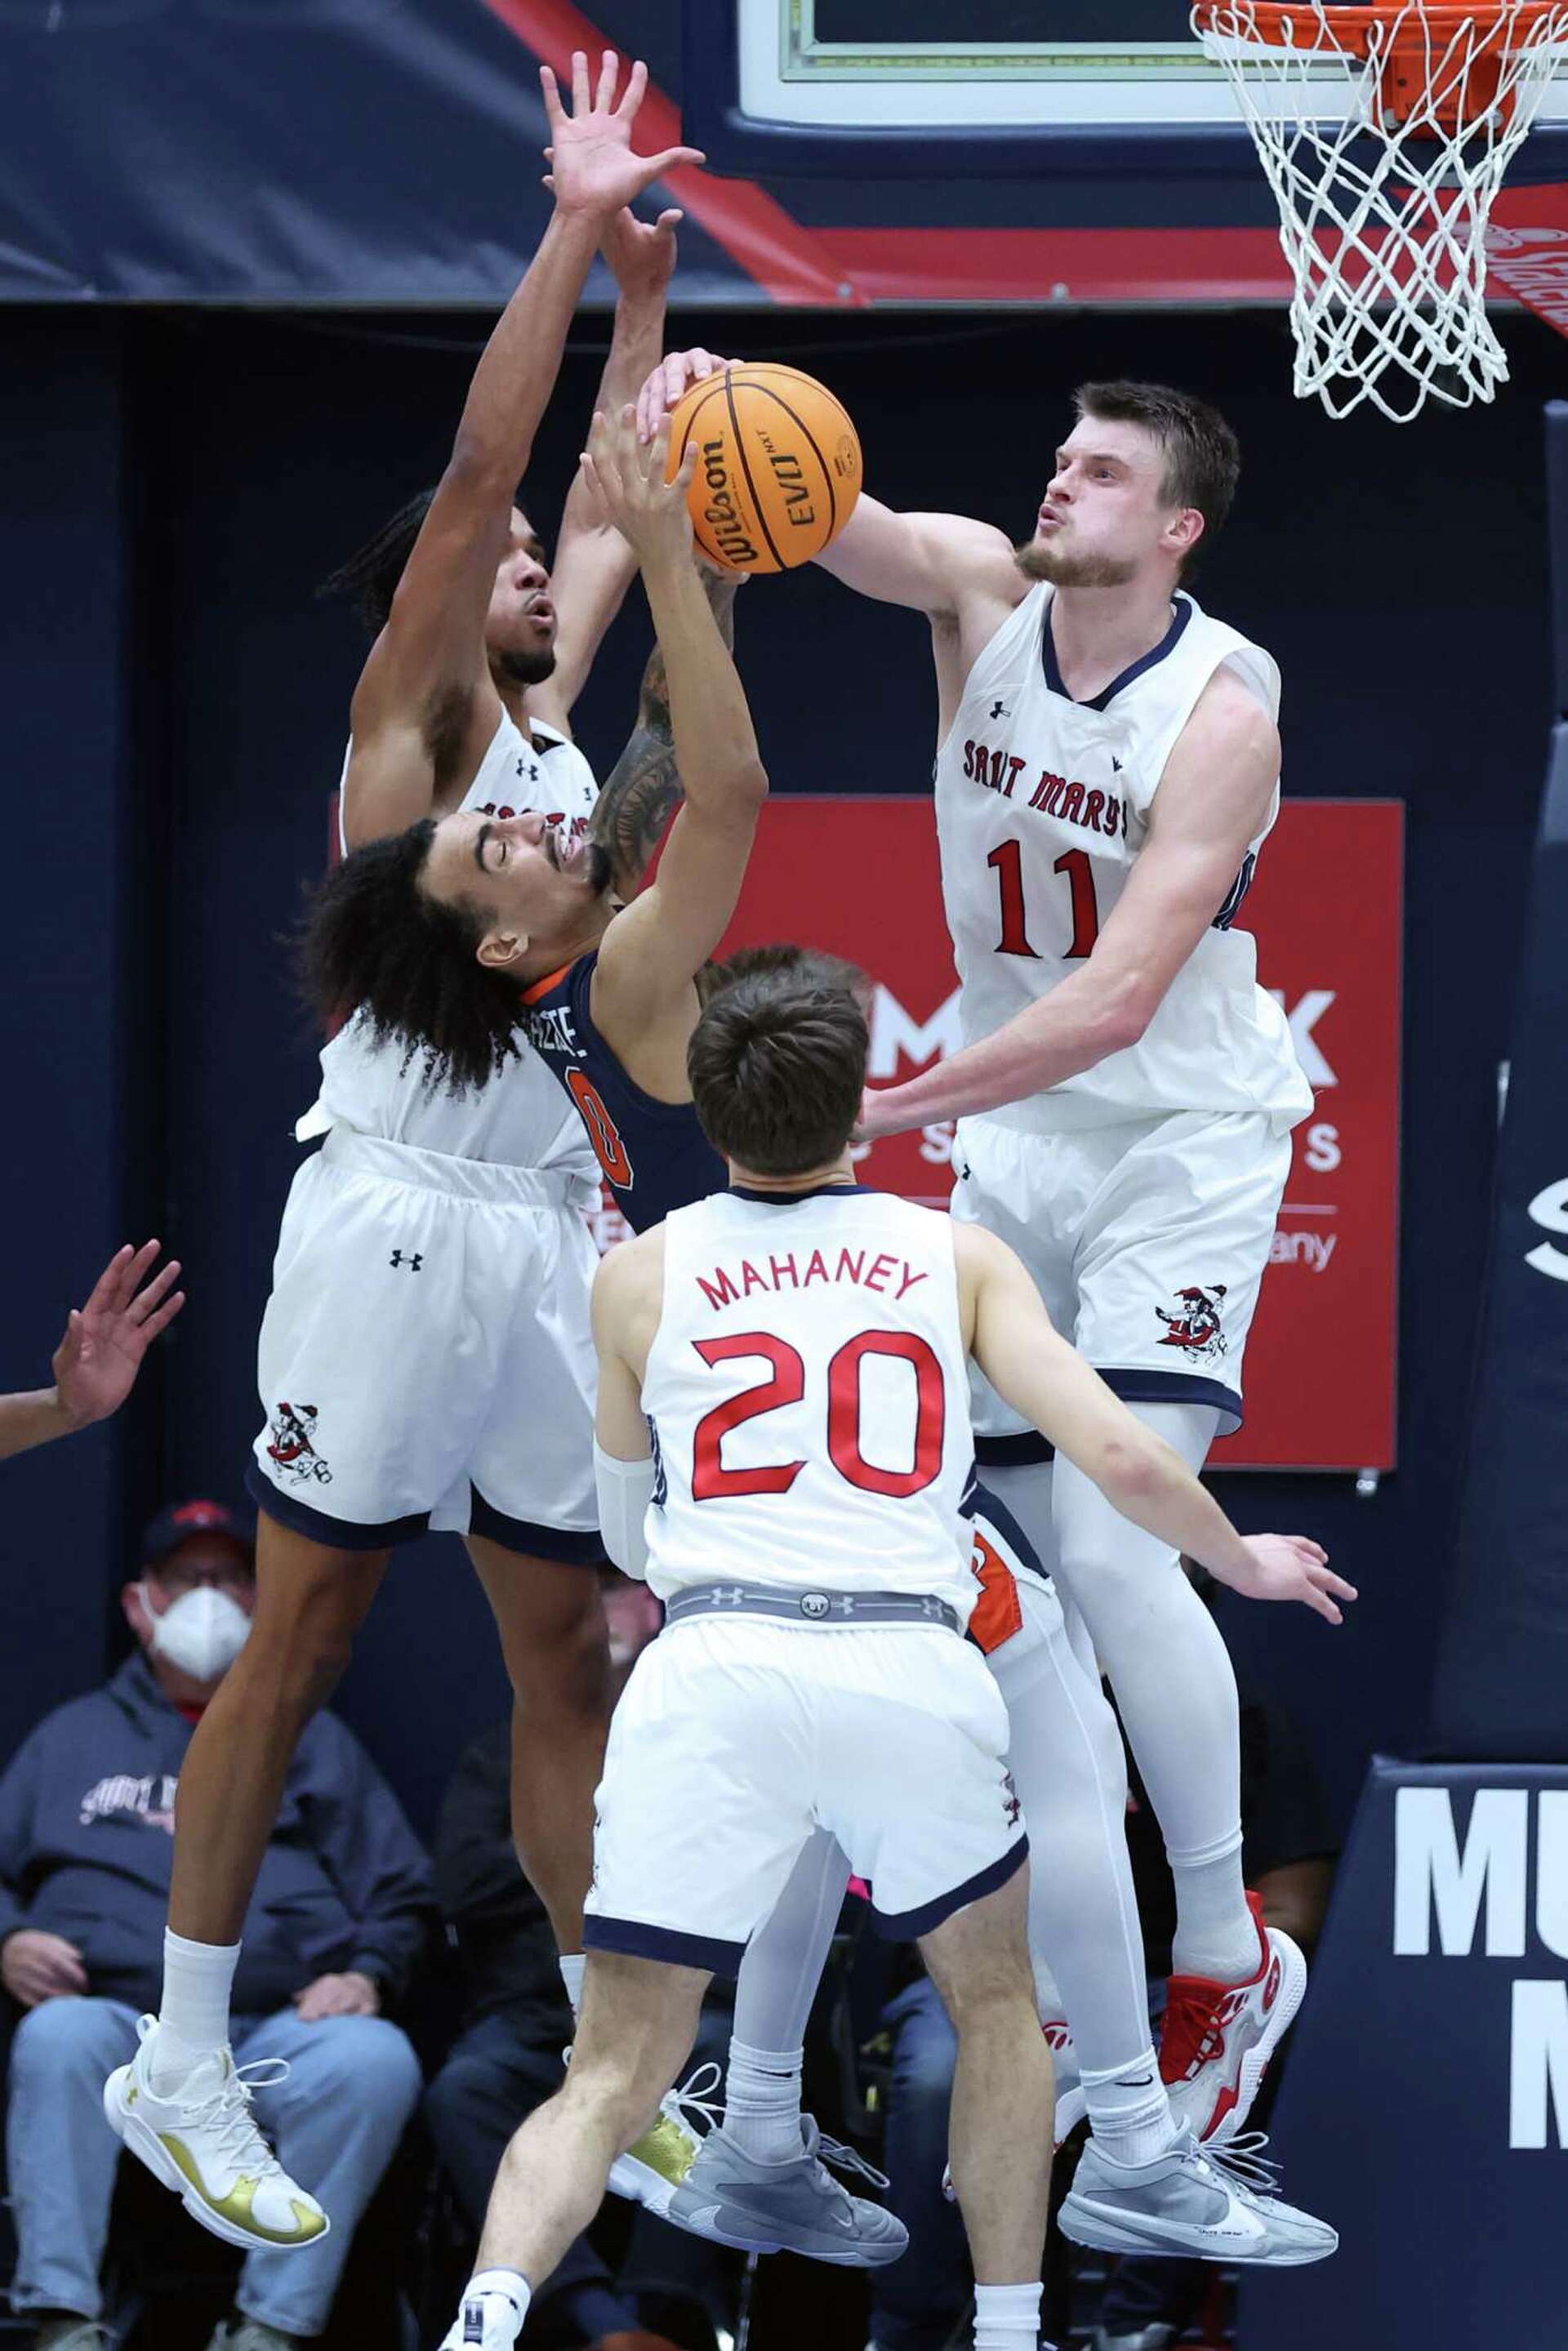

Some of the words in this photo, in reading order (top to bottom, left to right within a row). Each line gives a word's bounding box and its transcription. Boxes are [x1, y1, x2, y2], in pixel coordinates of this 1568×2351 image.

[703, 439, 758, 563] Wilson
[987, 839, 1099, 960] 11
[696, 1248, 929, 1311] MAHANEY
[691, 1329, 946, 1502] 20
